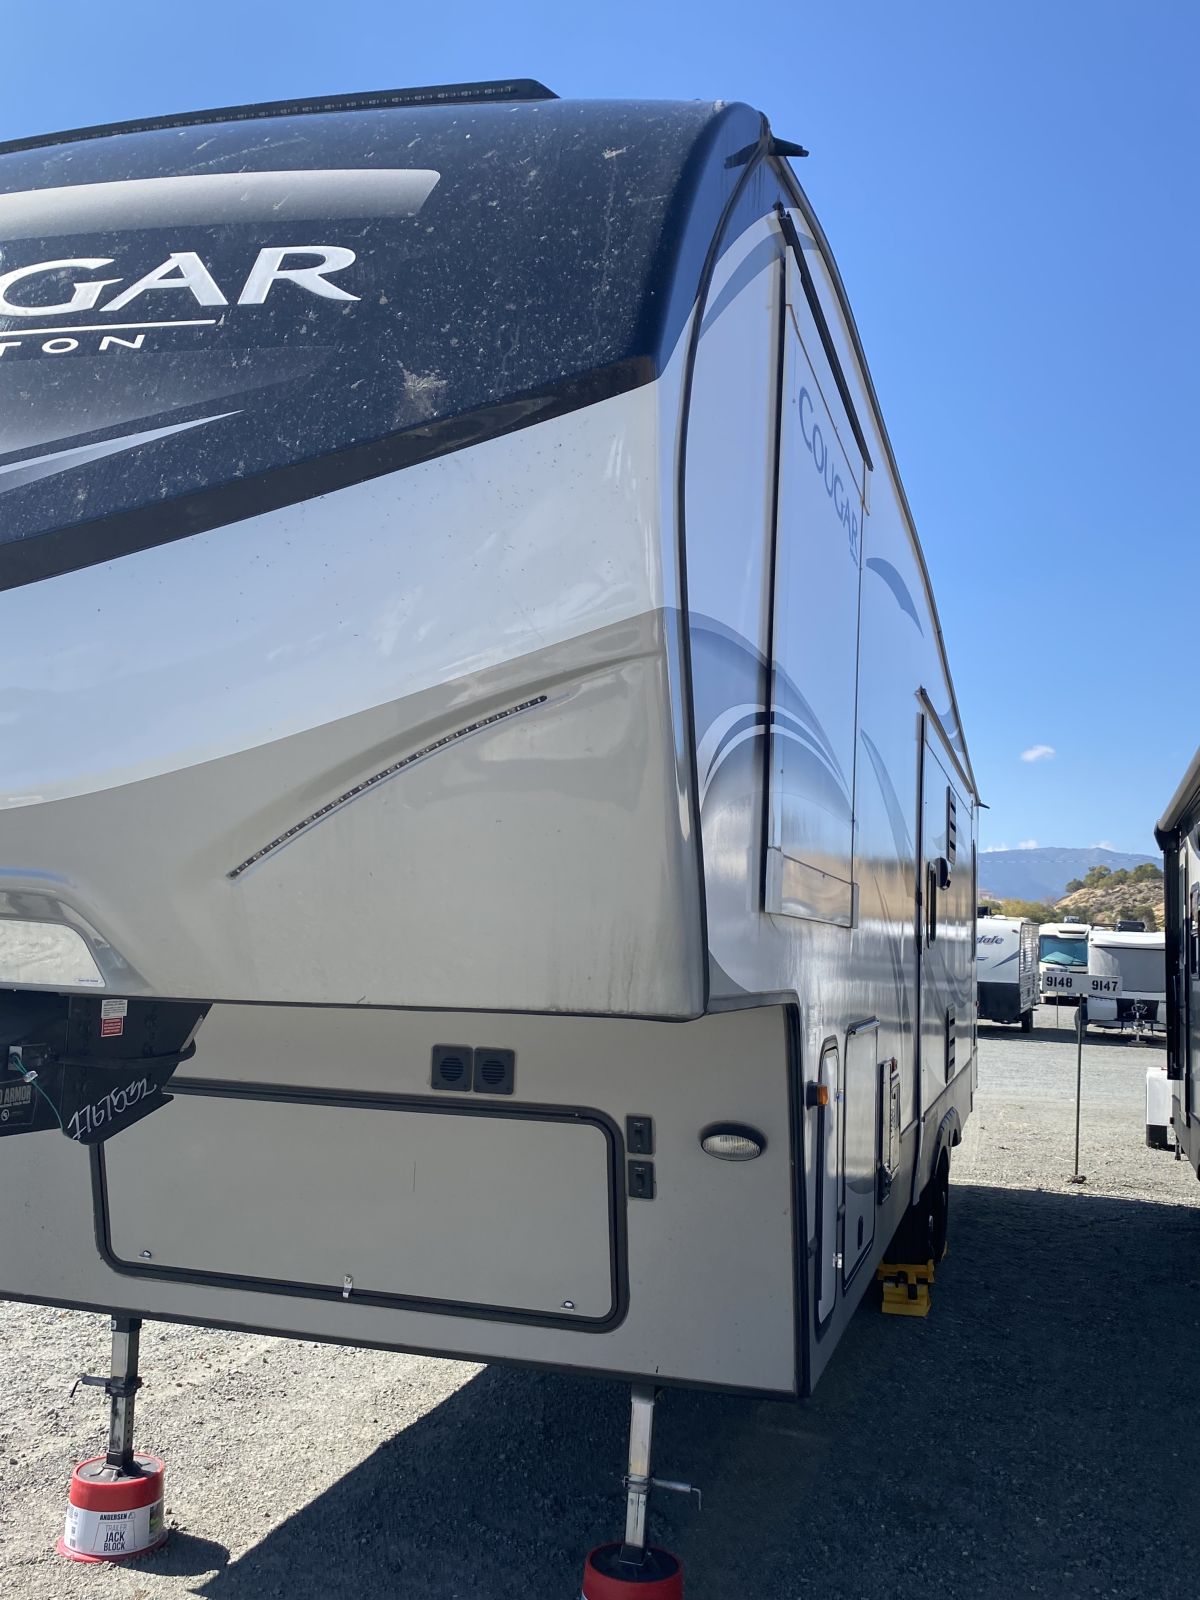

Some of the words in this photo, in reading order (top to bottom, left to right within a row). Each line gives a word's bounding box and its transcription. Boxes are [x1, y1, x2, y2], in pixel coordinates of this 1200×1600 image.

[798, 386, 858, 558] COUGAR
[1046, 976, 1073, 988] 9148
[1091, 979, 1118, 992] 9147
[4, 1085, 31, 1104] ARMOR
[100, 1513, 128, 1521] ANDERSEN
[104, 1531, 125, 1542] JACK
[103, 1542, 125, 1551] BLOCK
